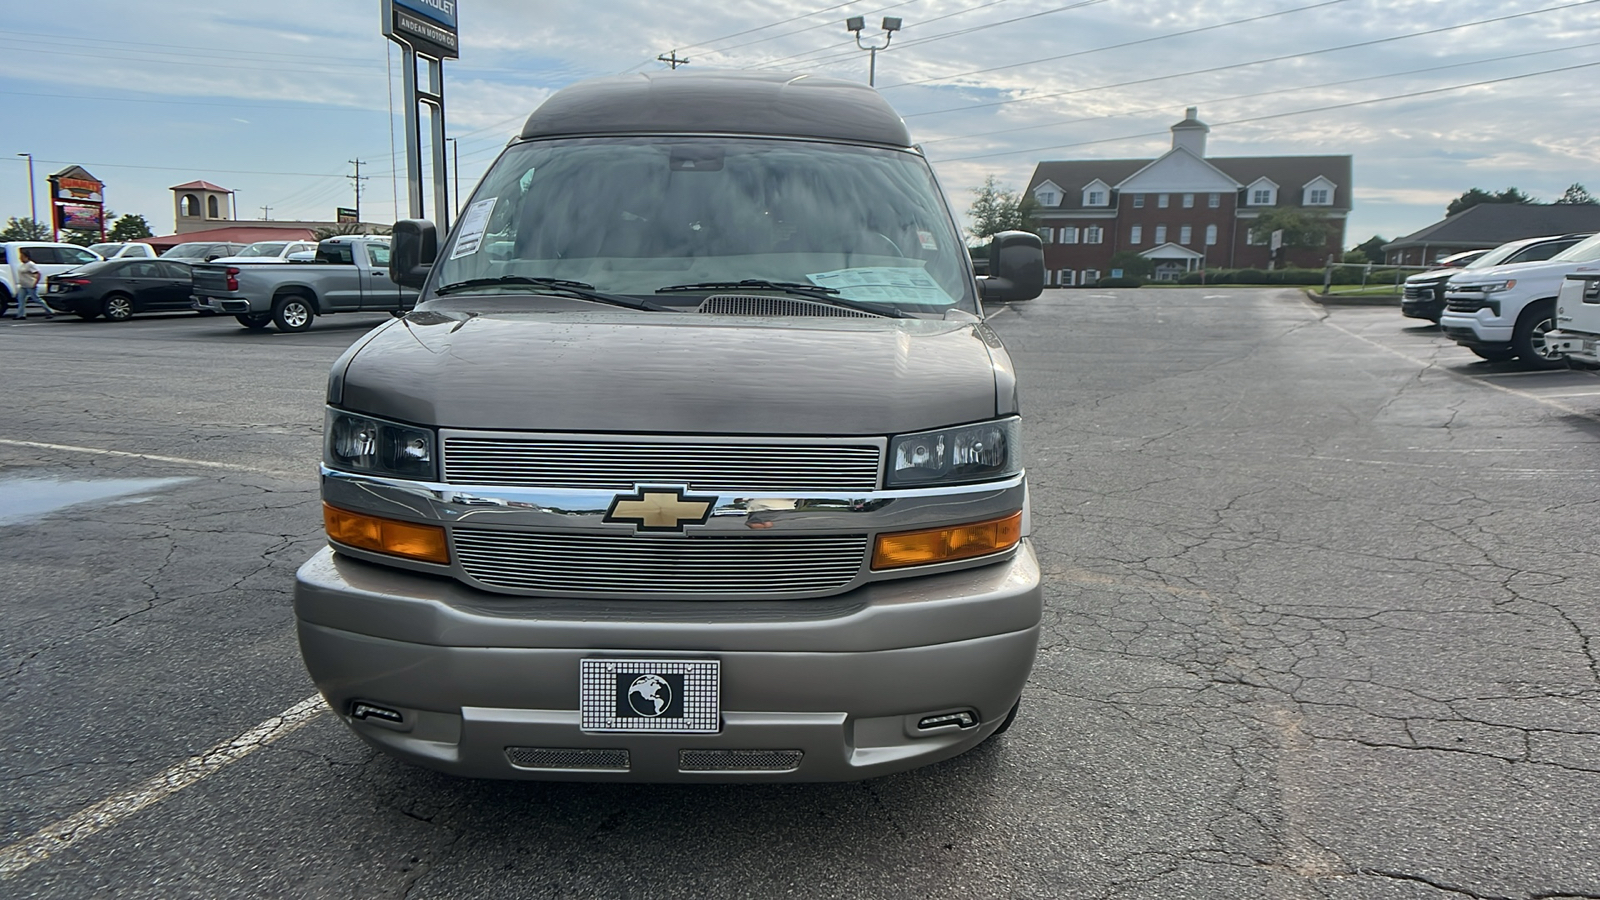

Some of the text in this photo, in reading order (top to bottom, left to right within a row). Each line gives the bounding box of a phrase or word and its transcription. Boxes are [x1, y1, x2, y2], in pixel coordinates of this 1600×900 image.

[402, 18, 454, 46] ANDEAN MOTOR CO
